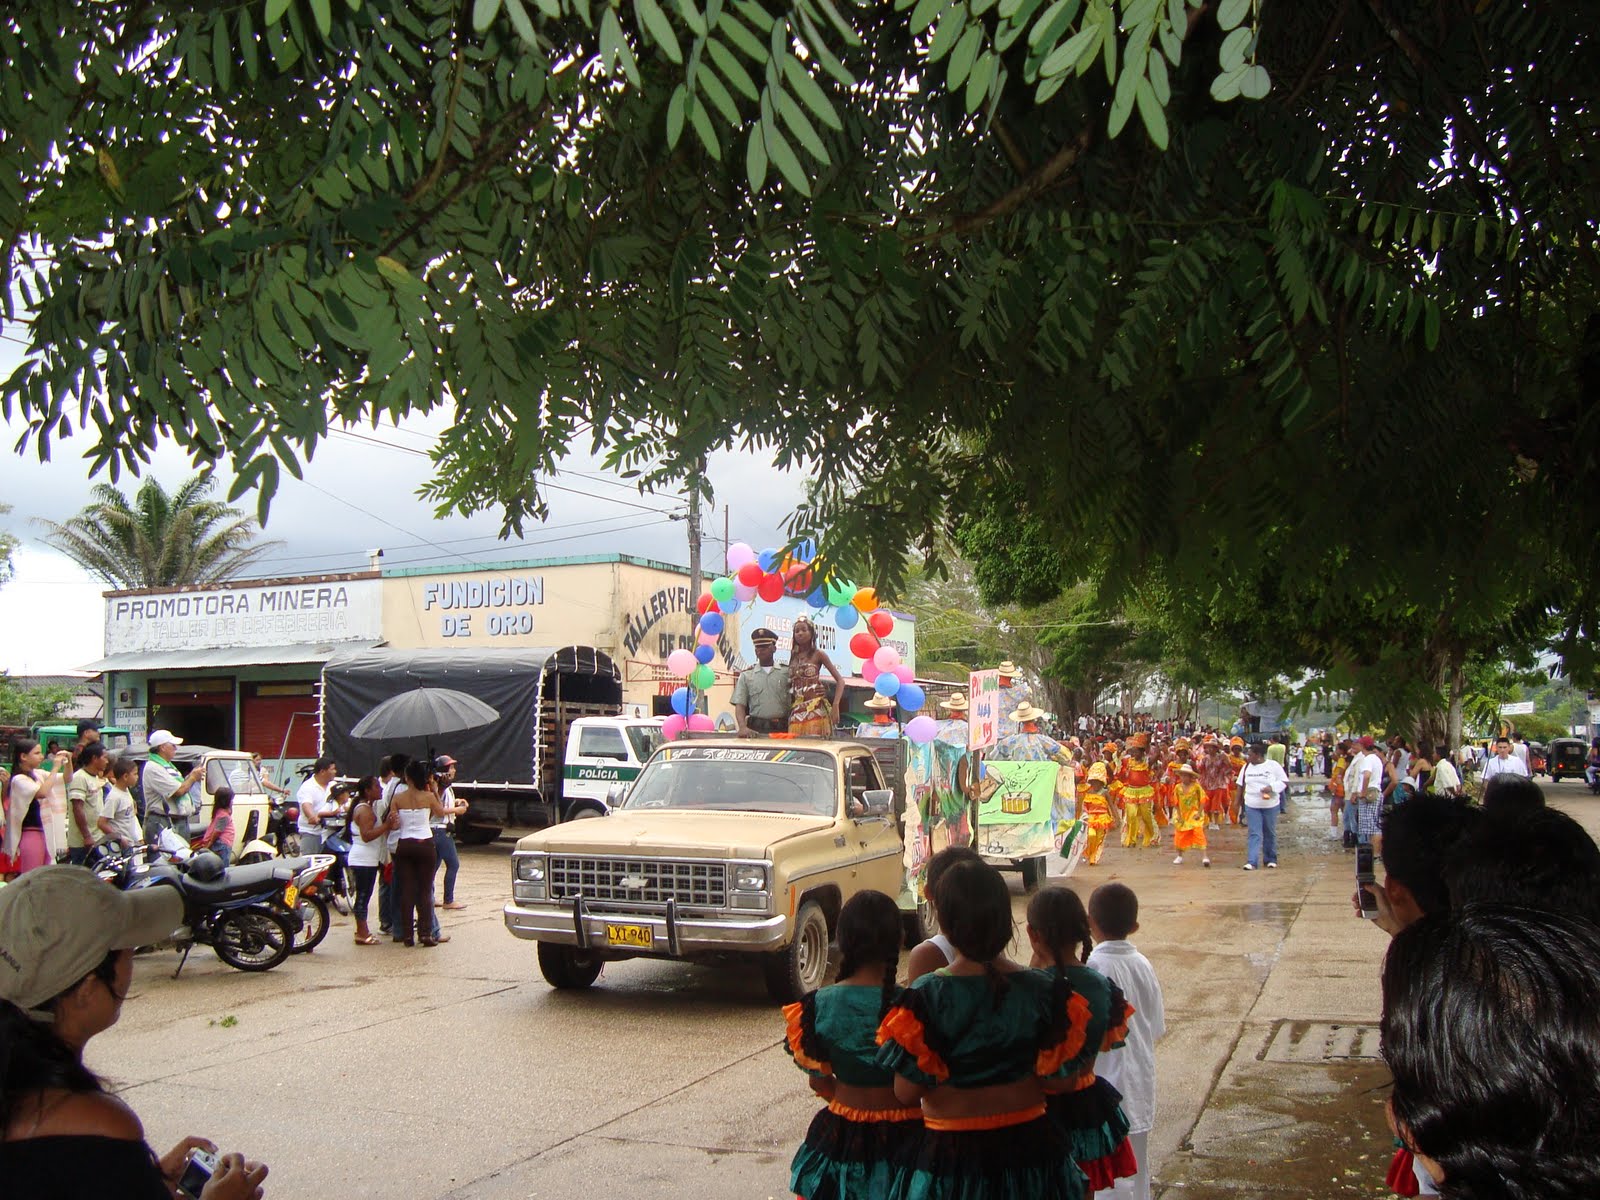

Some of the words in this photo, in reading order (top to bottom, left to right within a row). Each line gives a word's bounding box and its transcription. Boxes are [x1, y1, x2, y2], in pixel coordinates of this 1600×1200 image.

[116, 593, 250, 621] PROMOTORA
[259, 587, 349, 612] MINERA
[423, 576, 544, 610] FUNDICION
[152, 619, 209, 639] TALLER
[215, 617, 236, 636] DE
[242, 611, 348, 635] ORFEBRERIA
[441, 613, 471, 637] DE
[486, 611, 534, 636] ORO
[623, 590, 668, 658] TALLER
[578, 769, 619, 780] POLICIA
